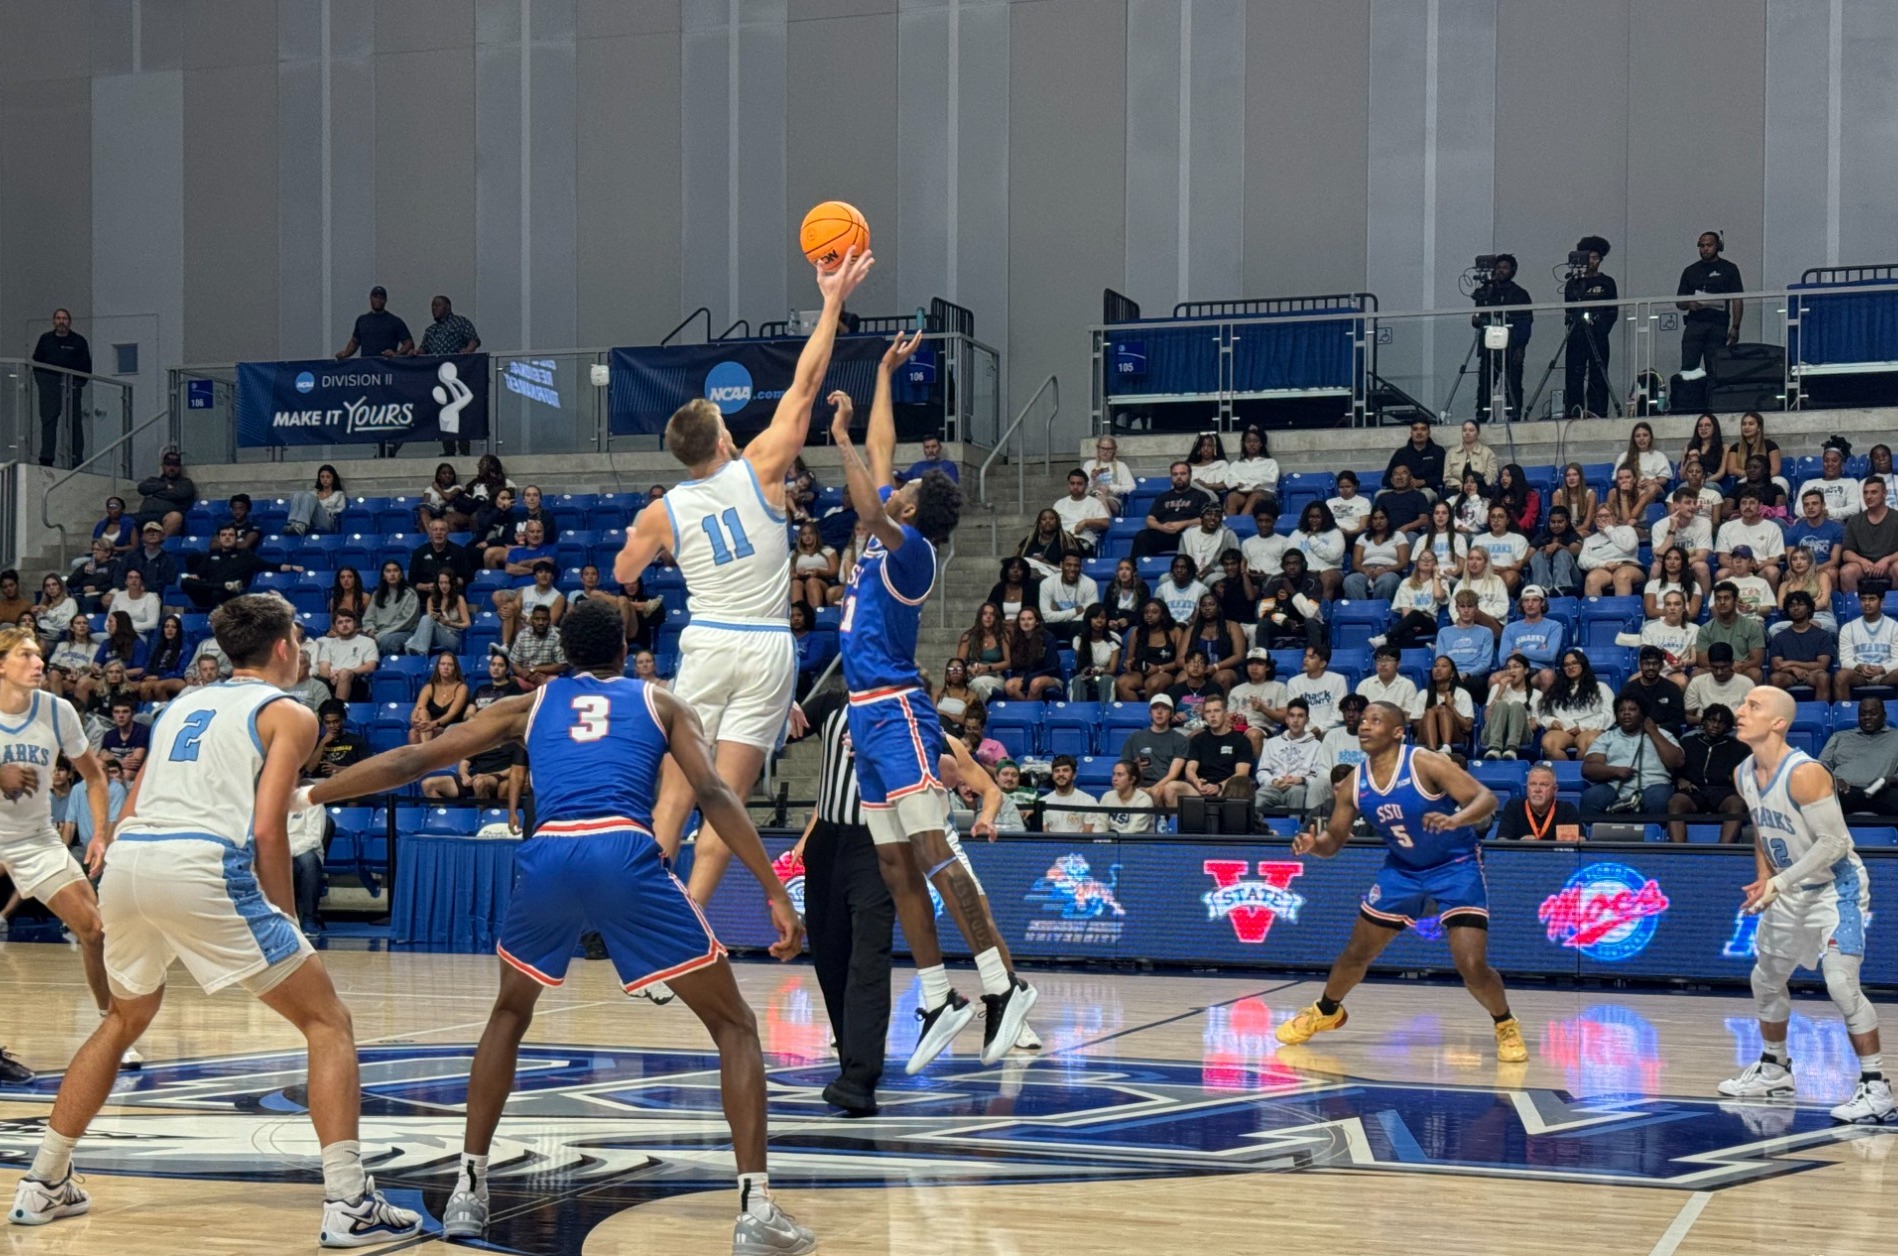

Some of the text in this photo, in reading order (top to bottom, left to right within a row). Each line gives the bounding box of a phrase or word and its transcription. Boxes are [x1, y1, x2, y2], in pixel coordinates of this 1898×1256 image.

[910, 372, 924, 381] 106
[1118, 362, 1134, 372] 105
[322, 374, 381, 387] DIVISION
[273, 411, 321, 427] MAKE
[325, 410, 343, 425] IT
[702, 507, 755, 566] 11
[569, 695, 610, 743] 3
[169, 709, 217, 762] 2
[0, 743, 49, 766] ARKS
[1377, 804, 1403, 823] SSU
[1391, 825, 1414, 847] 5
[1203, 860, 1304, 943] V
[1222, 886, 1286, 907] STATE
